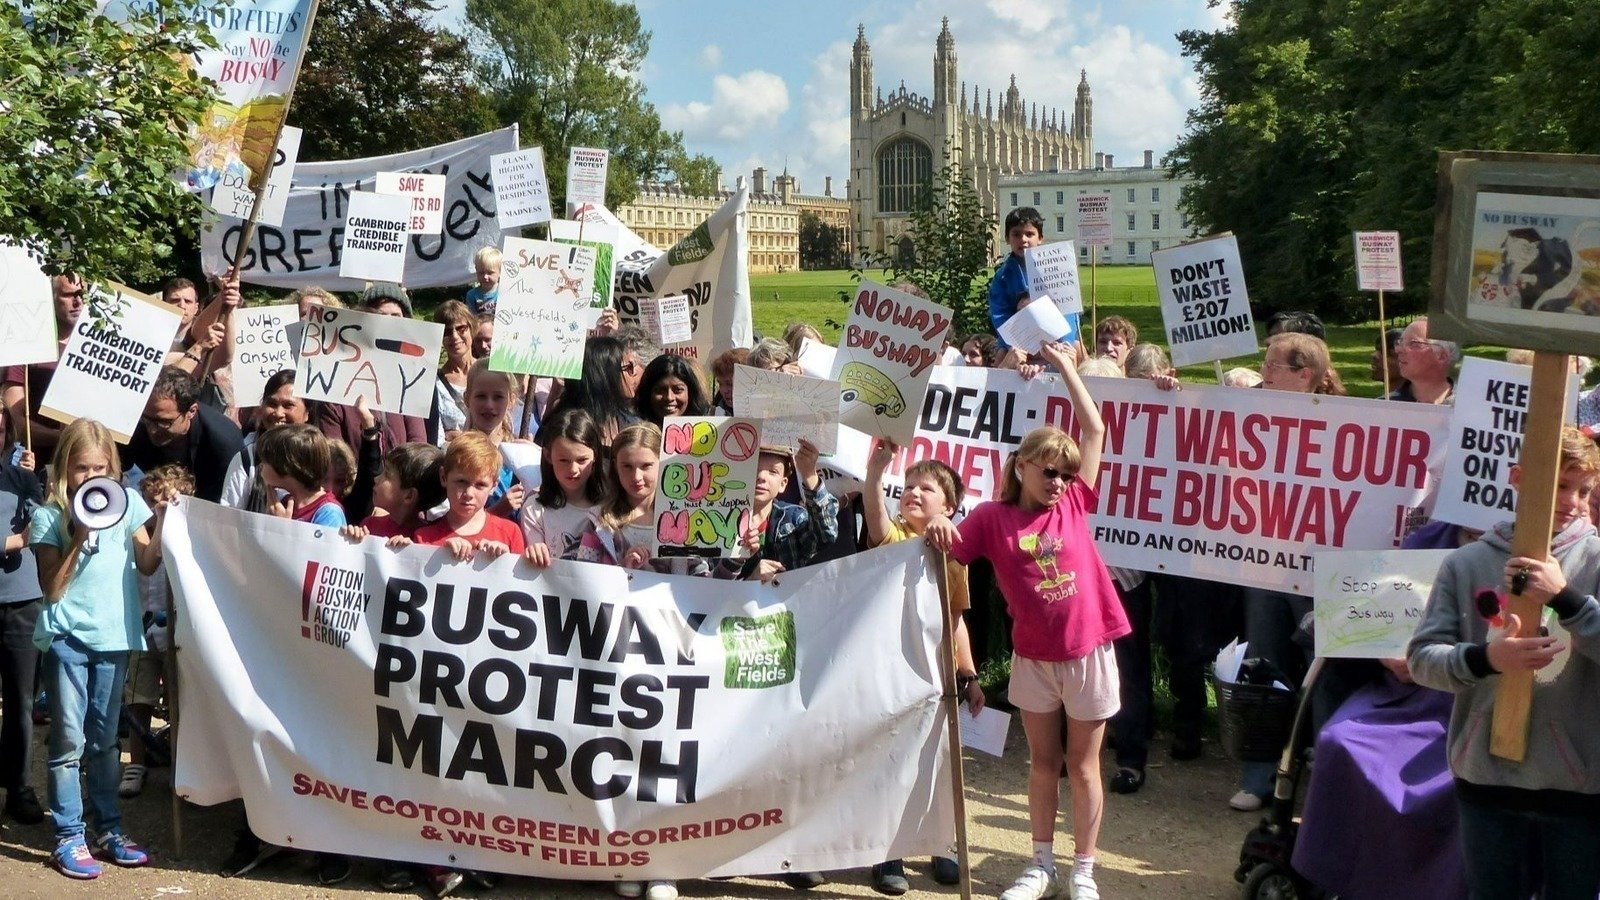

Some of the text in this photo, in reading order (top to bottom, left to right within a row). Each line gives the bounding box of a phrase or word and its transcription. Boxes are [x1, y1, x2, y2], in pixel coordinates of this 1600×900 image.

[224, 41, 245, 58] Say
[249, 37, 271, 59] NO
[498, 162, 535, 175] HIGHWAY
[508, 155, 528, 164] LANE
[398, 177, 425, 192] SAVE
[498, 181, 541, 193] HARDWICK
[509, 173, 525, 181] FOR
[428, 200, 441, 211] RD
[500, 189, 543, 201] RESIDENTS
[348, 216, 407, 232] CAMBRIDGE
[505, 206, 543, 218] MADNESS
[1483, 213, 1559, 228] NO BUSWAY
[346, 239, 403, 254] TRANSPORT
[353, 229, 399, 242] CREDIBLE
[518, 249, 560, 271] SAVE
[675, 248, 709, 261] Fields
[1033, 255, 1068, 268] HIGHWAY
[1042, 248, 1061, 256] LANE
[1033, 271, 1074, 284] HARDWICK
[1044, 265, 1059, 273] FOR
[1170, 258, 1225, 286] DON'T
[1035, 280, 1075, 292] RESIDENTS
[1172, 277, 1231, 304] WASTE
[309, 305, 338, 324] NO
[1182, 298, 1229, 323] £207
[236, 329, 255, 344] do
[1171, 314, 1250, 345] MILLION!
[78, 322, 164, 365] CAMBRIDGE
[847, 324, 937, 378] BUSWAY
[80, 341, 148, 376] CREDIBLE
[65, 352, 150, 394] TRANSPORT
[306, 358, 426, 414] WAY
[1485, 379, 1529, 408] KEE
[663, 421, 718, 457] NO
[1175, 405, 1327, 478] WASTE
[1332, 422, 1431, 490] OUR
[1461, 427, 1523, 459] BUSW
[1463, 454, 1499, 481] ON
[1172, 469, 1361, 549] BUSWAY
[1463, 480, 1516, 513] ROA
[1094, 526, 1140, 546] FIND
[1143, 533, 1174, 551] AN
[1177, 536, 1270, 565] ON-ROAD
[320, 565, 364, 591] COTON
[1342, 576, 1414, 593] Stop the
[317, 585, 371, 613] BUSWAY
[314, 605, 361, 632] ACTION
[381, 576, 707, 666] BUSWAY
[314, 624, 351, 650] GROUP
[740, 650, 780, 666] West
[374, 643, 710, 730] PROTEST
[737, 666, 787, 682] Fields
[375, 704, 698, 804] MARCH
[293, 772, 783, 847] SAVE COTON GREEN CORRIDOR
[420, 824, 650, 867] & WEST FIELDS
